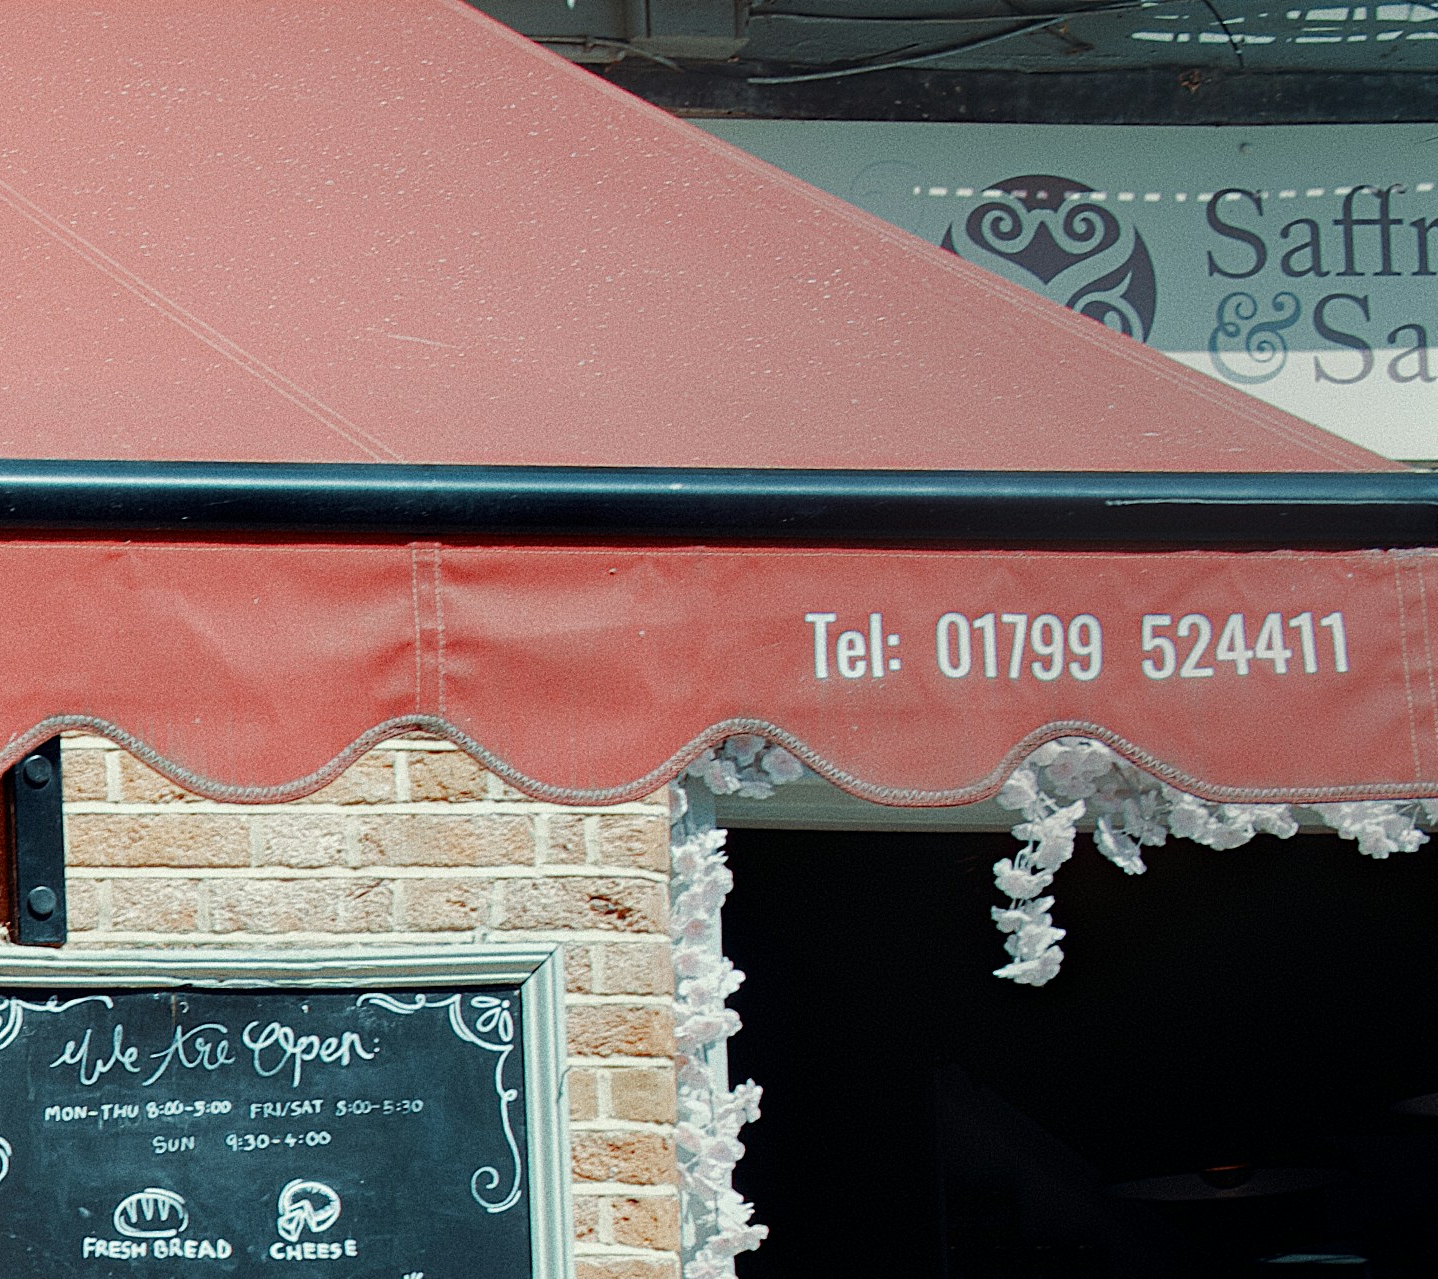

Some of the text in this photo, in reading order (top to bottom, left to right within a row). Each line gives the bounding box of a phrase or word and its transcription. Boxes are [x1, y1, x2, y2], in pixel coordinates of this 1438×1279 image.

[1208, 291, 1438, 386] & Sa
[804, 611, 1350, 682] Tel: 01799 524411
[50, 1020, 381, 1087] We Are Open:
[44, 1104, 140, 1122] MON-THU
[145, 1100, 232, 1119] 8:00-5:00
[250, 1099, 324, 1118] FRI/SAT
[152, 1131, 332, 1154] SUN 9:30-4:00
[83, 1237, 232, 1261] FRESH BREAD
[270, 1239, 358, 1261] CHEESE
